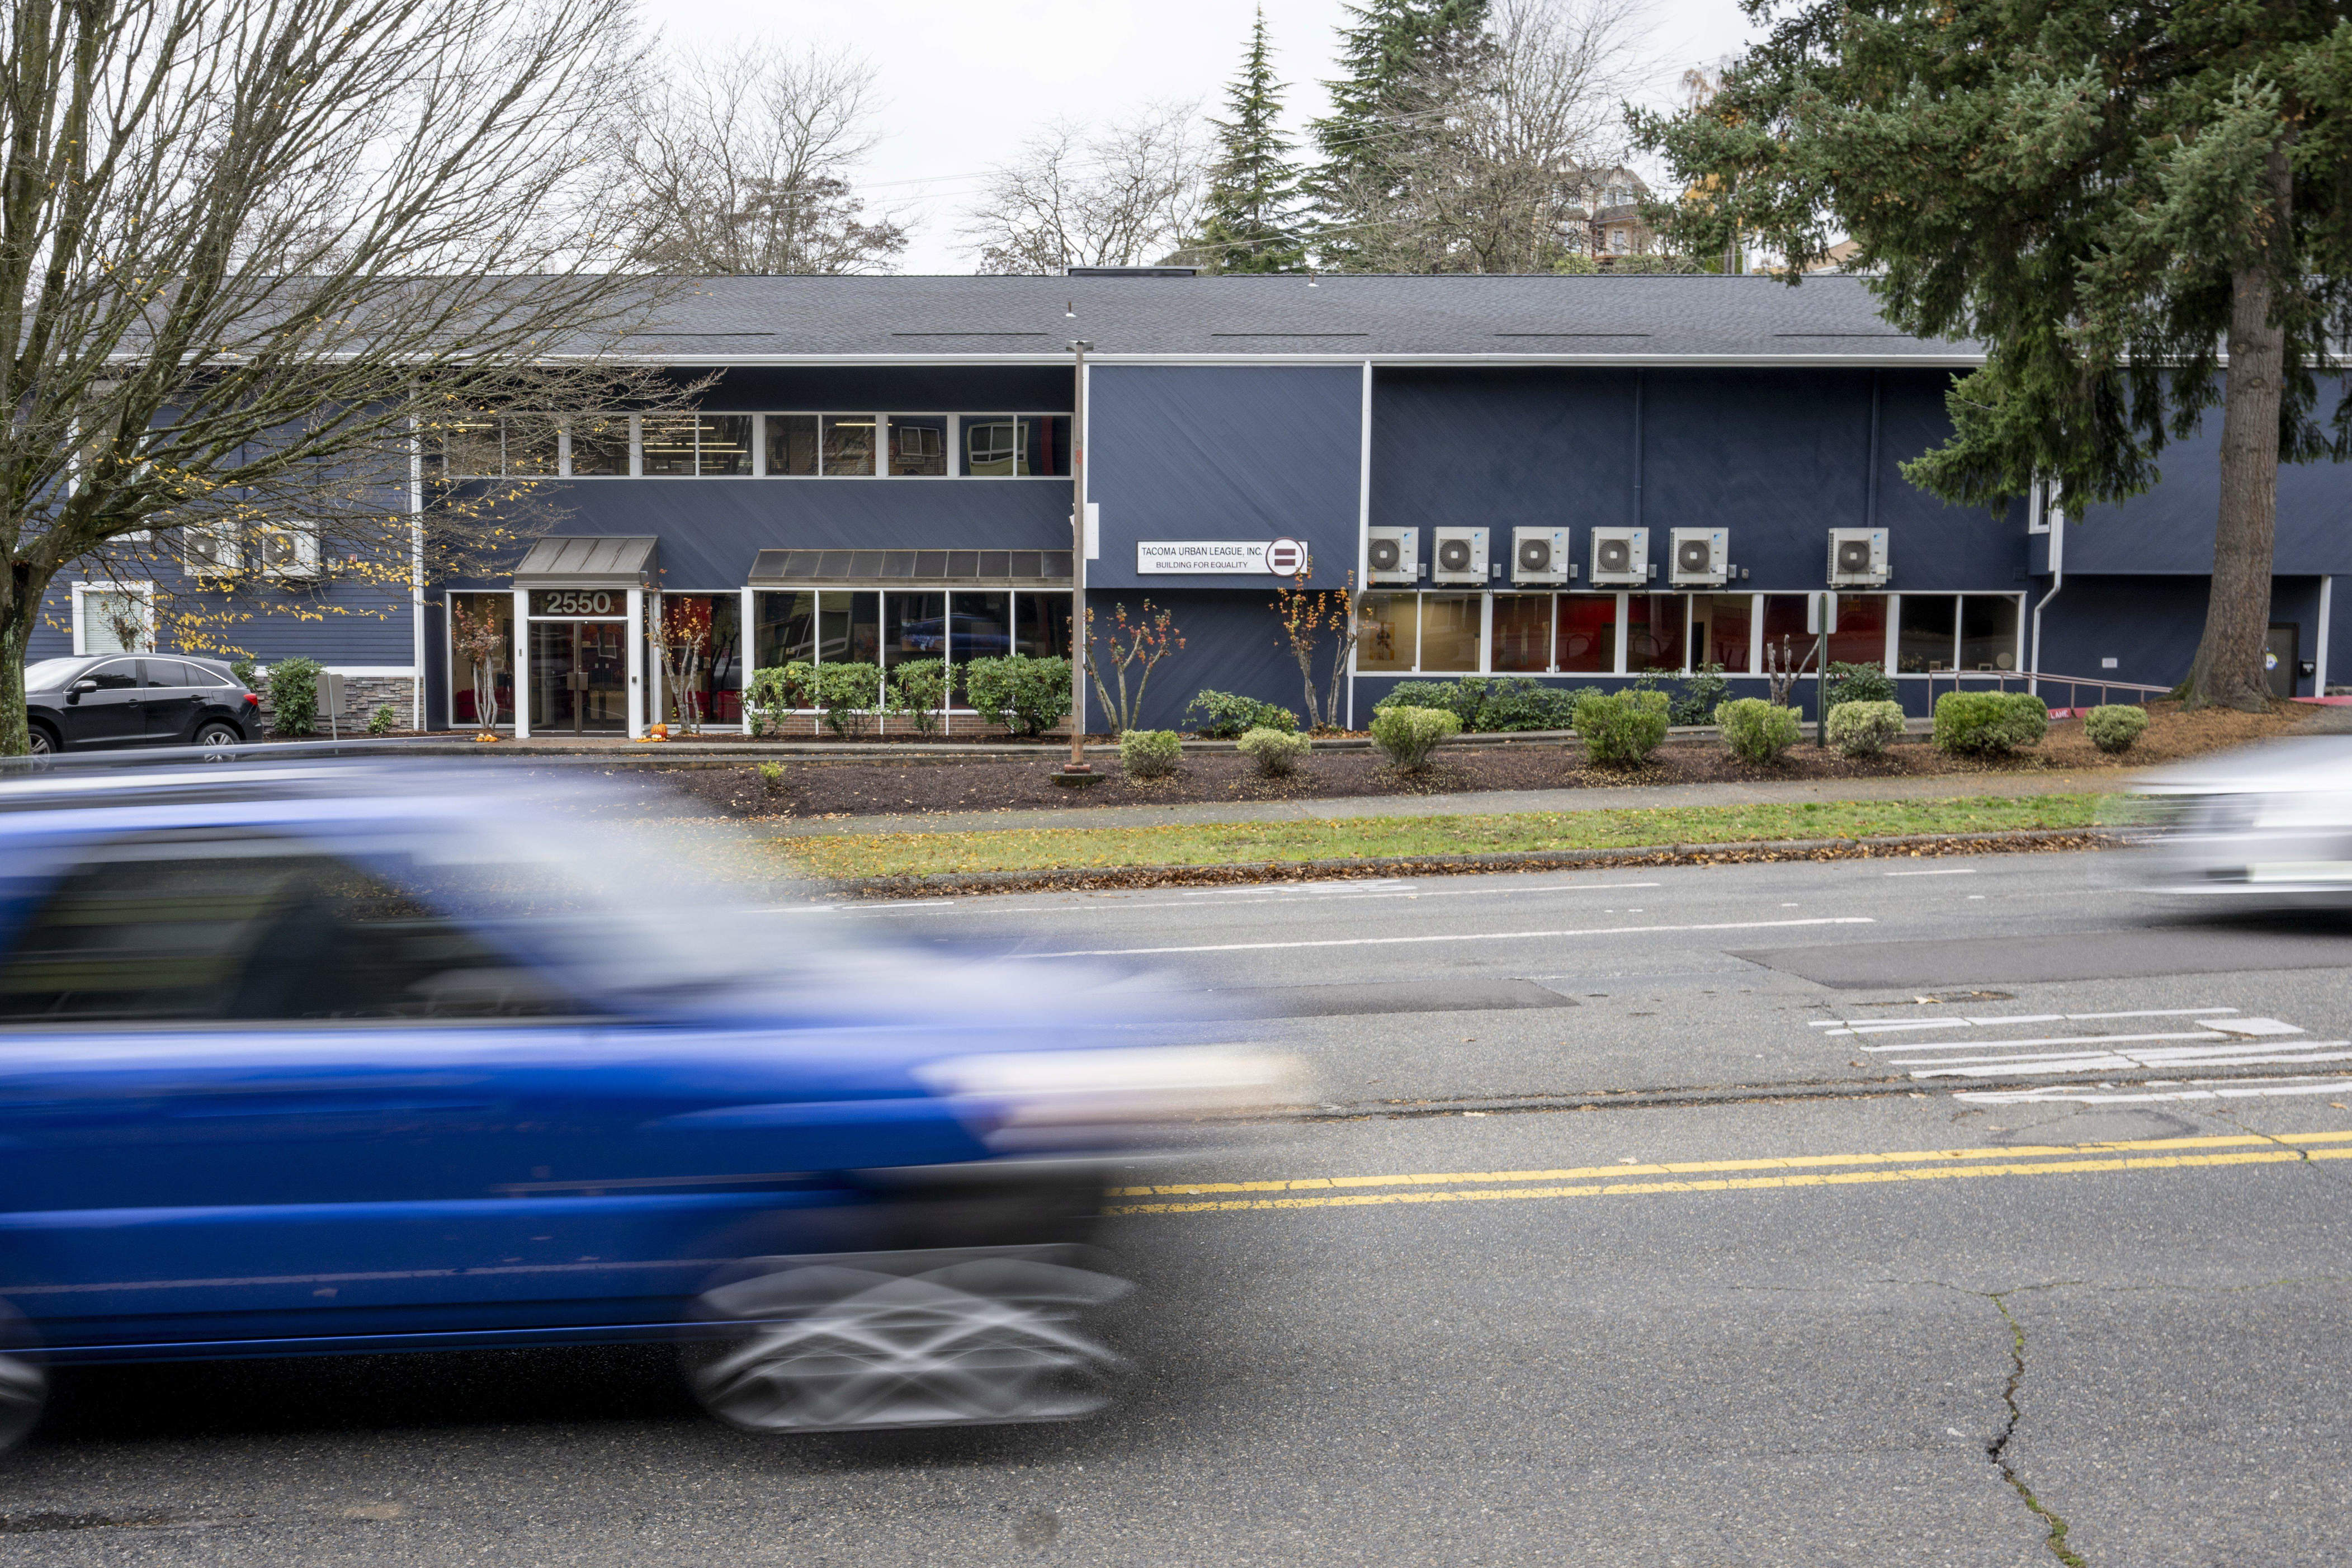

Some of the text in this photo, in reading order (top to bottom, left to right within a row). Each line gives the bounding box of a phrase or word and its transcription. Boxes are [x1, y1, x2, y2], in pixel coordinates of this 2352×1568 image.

[1141, 547, 1262, 557] TACOMA URBAN LEAGUE, INC.
[546, 592, 611, 613] 2550
[2049, 710, 2070, 720] LANE
